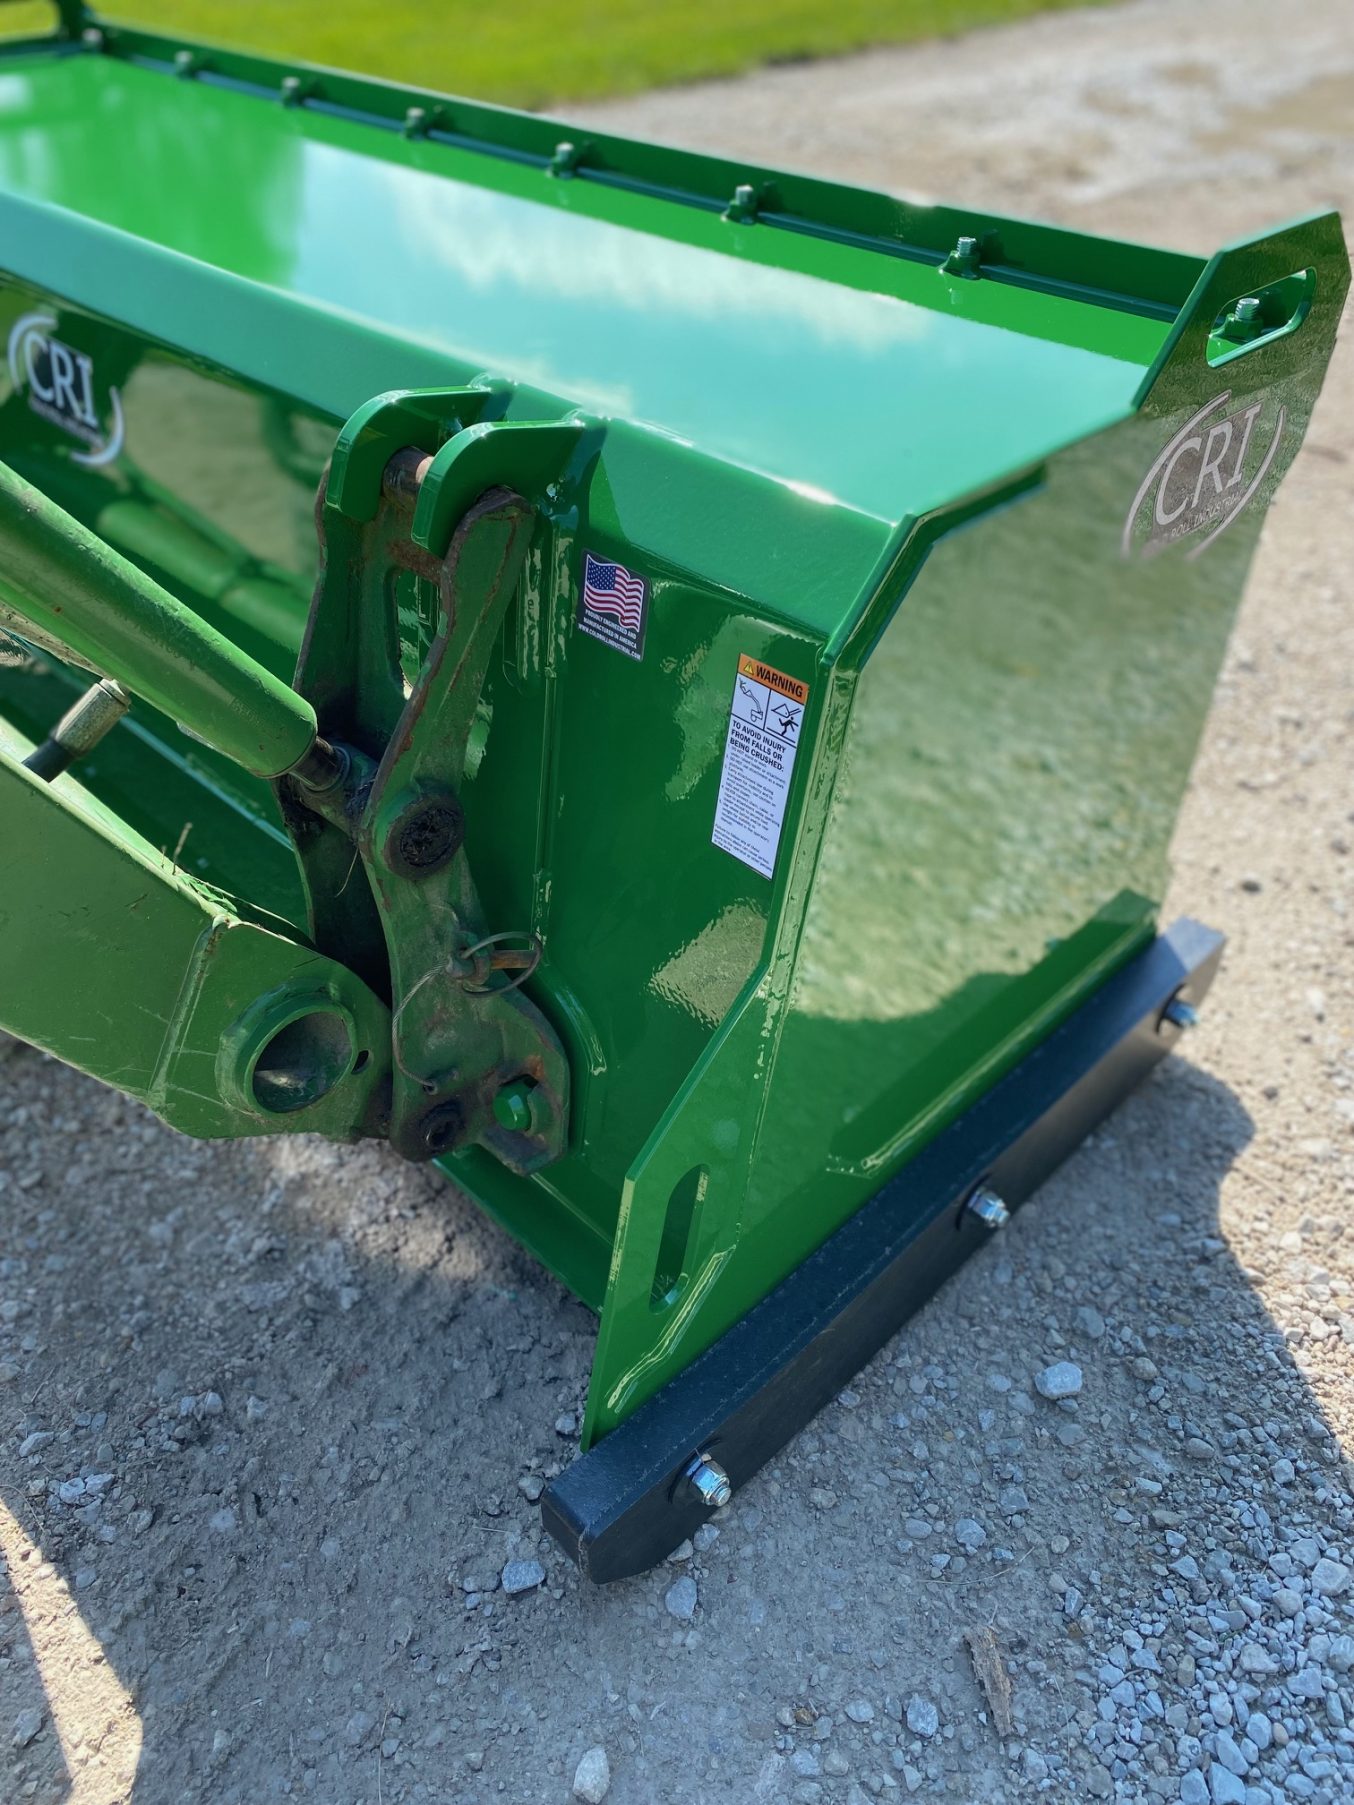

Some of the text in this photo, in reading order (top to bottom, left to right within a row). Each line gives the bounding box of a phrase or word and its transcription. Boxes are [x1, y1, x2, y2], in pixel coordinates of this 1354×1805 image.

[23, 331, 98, 427] CRI
[1156, 404, 1262, 525] CRI
[756, 665, 803, 698] WARNING
[731, 729, 750, 744] FROM
[752, 740, 771, 755] FALLS
[773, 751, 783, 761] OR
[733, 720, 786, 753] TO AVOID INJURY
[730, 737, 750, 753] BEING
[751, 749, 784, 772] CRUSHED:
